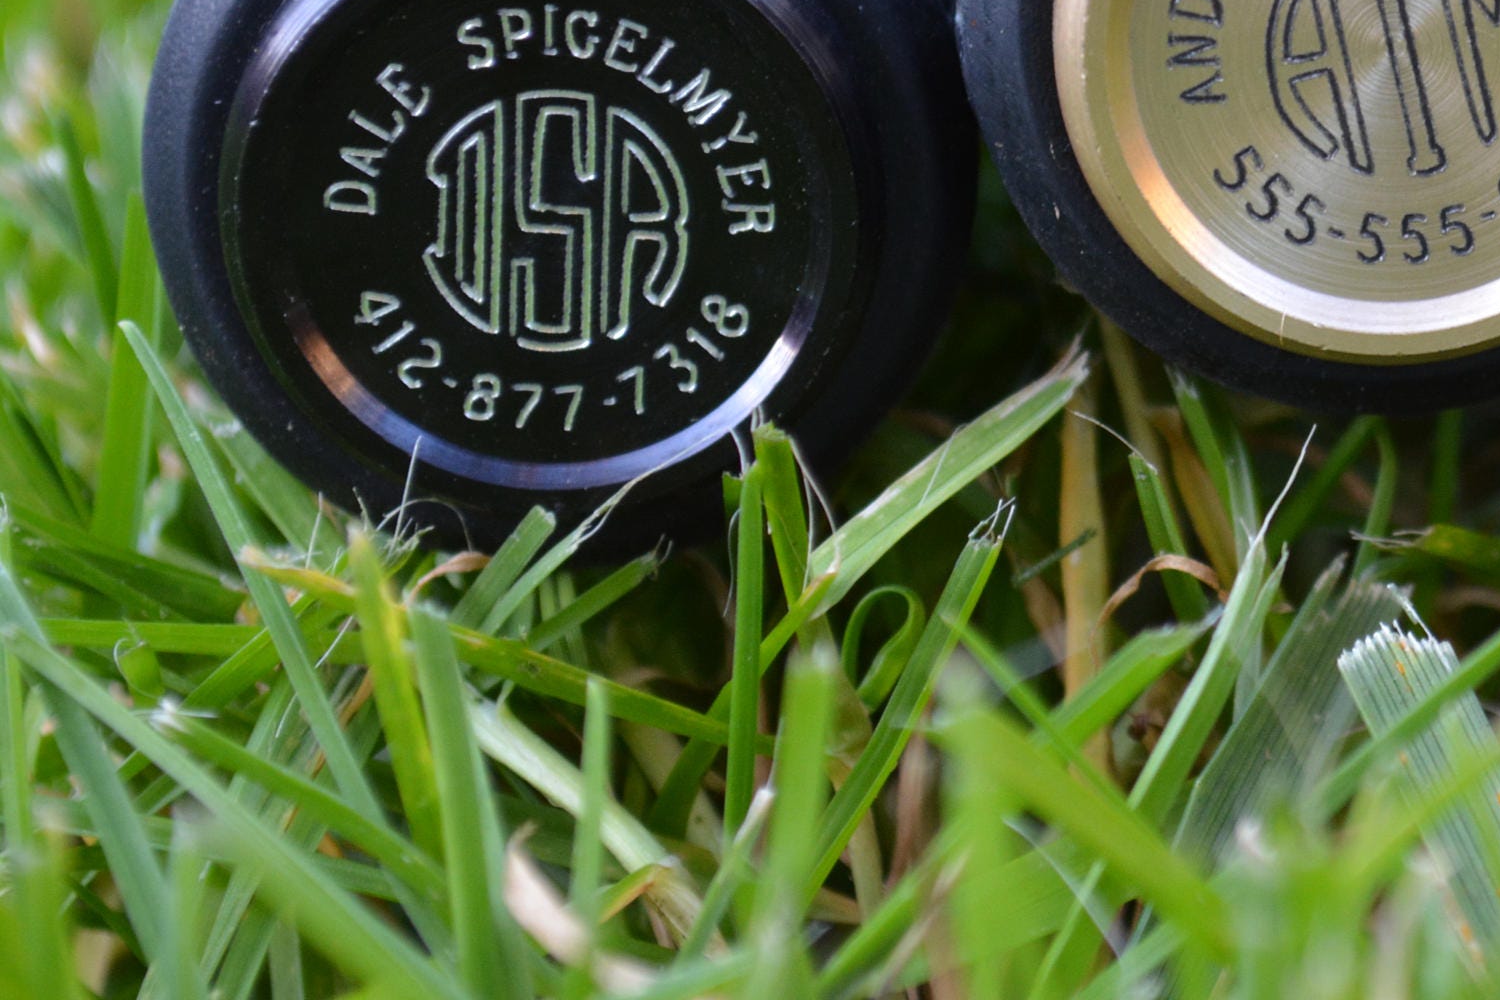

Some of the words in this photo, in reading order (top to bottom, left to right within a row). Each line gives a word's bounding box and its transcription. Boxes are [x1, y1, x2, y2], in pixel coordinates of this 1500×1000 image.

[324, 62, 431, 216] DALE
[457, 3, 776, 236] SPIGELMYER
[353, 290, 749, 432] 412-877-7318
